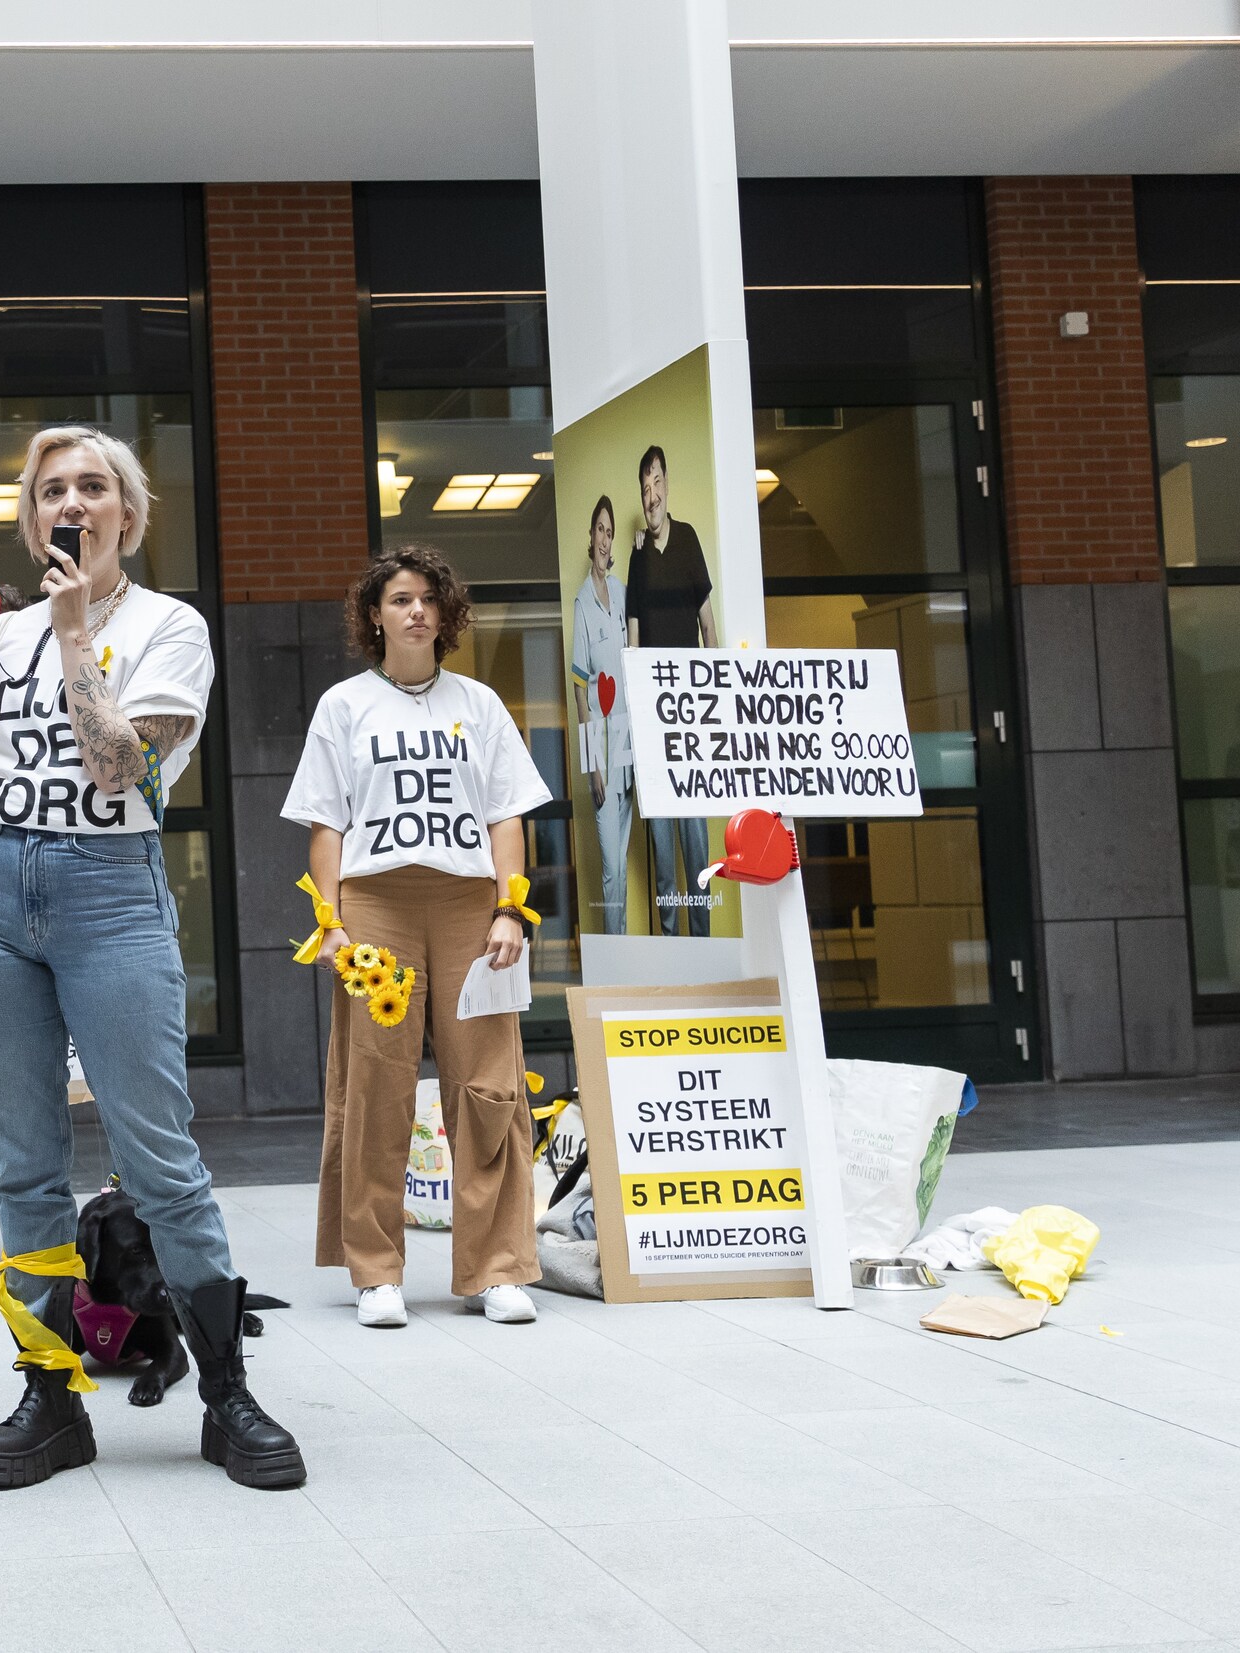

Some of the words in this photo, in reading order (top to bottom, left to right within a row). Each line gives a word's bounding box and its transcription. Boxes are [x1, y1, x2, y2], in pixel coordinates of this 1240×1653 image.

[689, 660, 731, 688] DE
[735, 659, 868, 689] WACHTRIJ
[656, 692, 722, 725] GGZ
[735, 692, 844, 725] NODIG?
[12, 722, 83, 770] DE
[370, 730, 468, 765] LIJM
[664, 732, 703, 762] ER
[710, 732, 770, 762] ZIJN
[777, 732, 822, 760] NOG
[831, 732, 909, 760] 90.000
[394, 768, 452, 805] DE
[668, 767, 834, 798] WACHTENDEN
[837, 767, 894, 797] VOOR
[897, 768, 916, 797] U
[365, 812, 482, 856] ZORG
[656, 890, 723, 909] ontdekdezorg.nl
[619, 1029, 680, 1048] STOP
[688, 1025, 782, 1046] SUICIDE
[678, 1069, 722, 1091] DIT
[637, 1098, 772, 1123] SYSTEEM
[628, 1128, 787, 1153] VERSTRIKT
[631, 1183, 648, 1207] 5
[659, 1180, 722, 1206] PER
[733, 1178, 803, 1204] DAG
[639, 1226, 807, 1250] #LIJMDEZORG
[654, 1253, 693, 1261] SEPTEMBER
[694, 1252, 719, 1260] WORLD
[748, 1250, 790, 1258] PREVENTION
